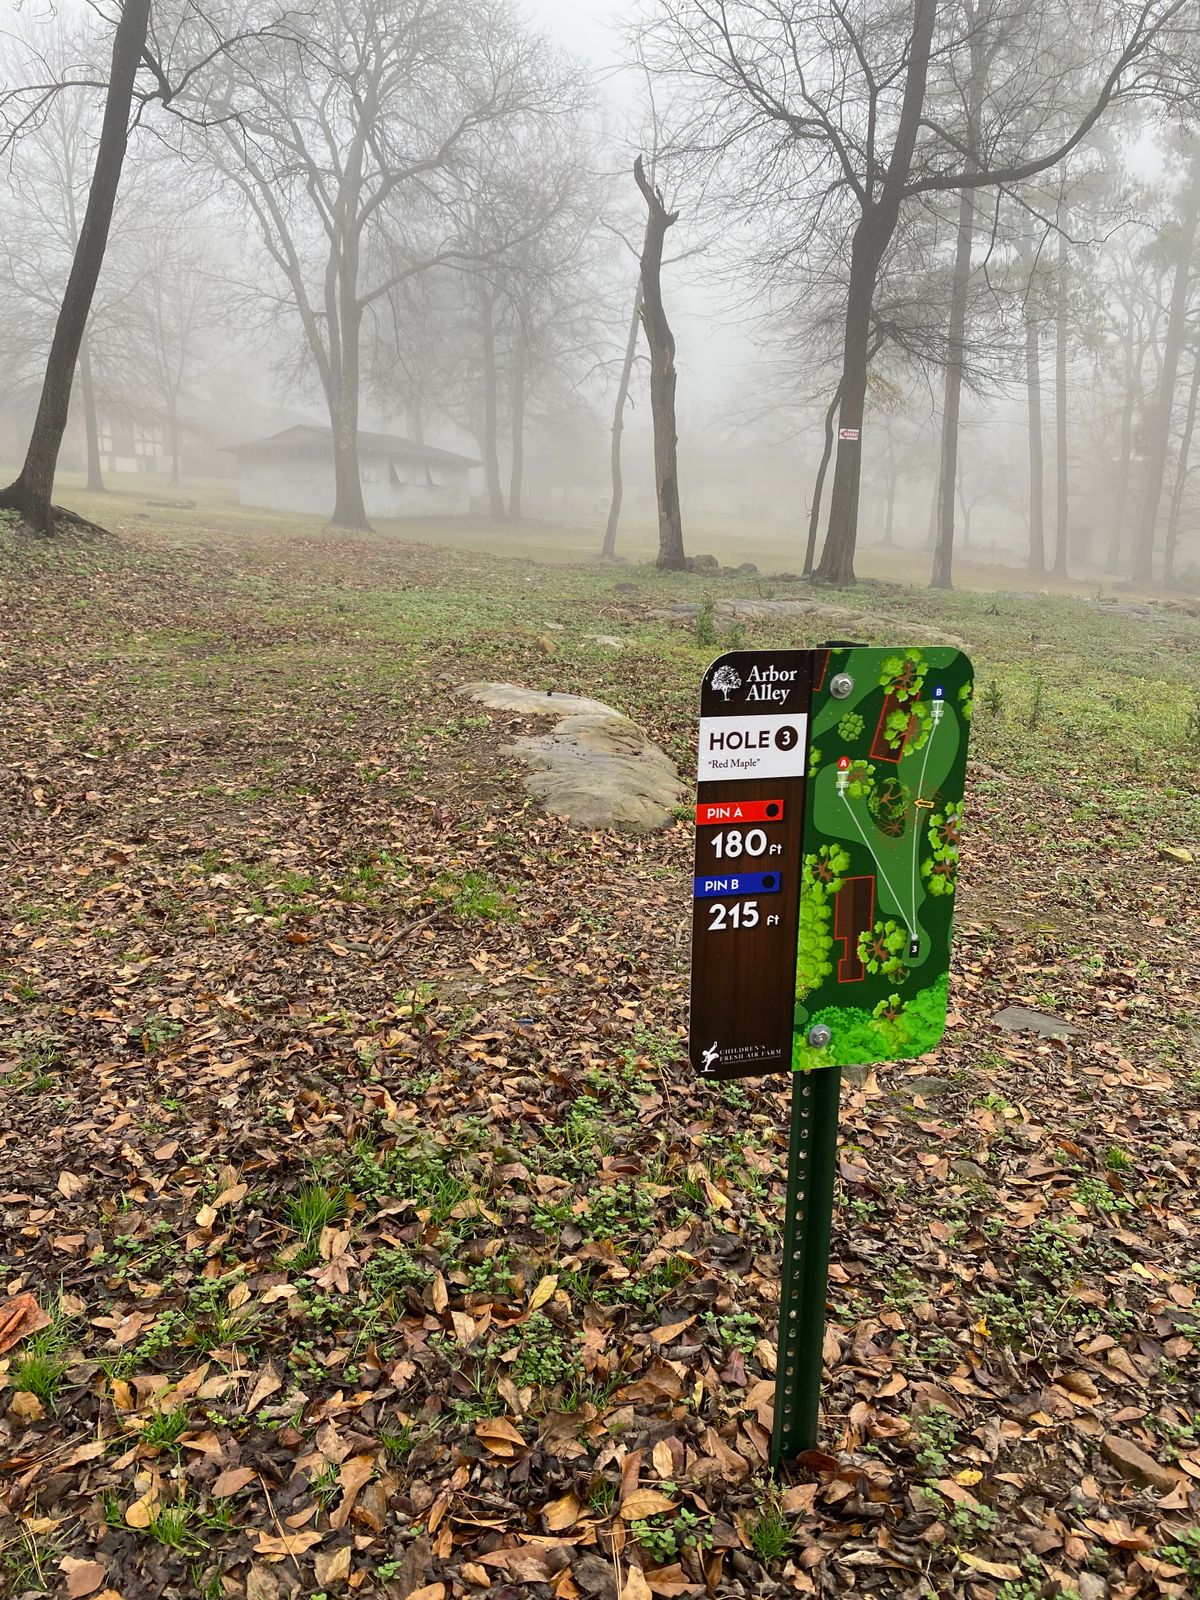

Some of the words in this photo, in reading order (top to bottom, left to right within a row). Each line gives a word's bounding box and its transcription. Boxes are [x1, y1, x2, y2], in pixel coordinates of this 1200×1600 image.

[746, 665, 798, 682] Arbor
[745, 684, 790, 705] Alley
[935, 688, 942, 696] B
[709, 730, 770, 750] HOLE
[781, 730, 791, 745] 3
[840, 759, 847, 767] A
[707, 807, 730, 819] PIN
[733, 807, 743, 817] A
[710, 829, 767, 858] 180
[705, 880, 728, 891] PIN
[731, 879, 740, 890] B
[707, 901, 759, 931] 215
[719, 1053, 744, 1062] FRESH
[761, 1049, 782, 1057] FARM
